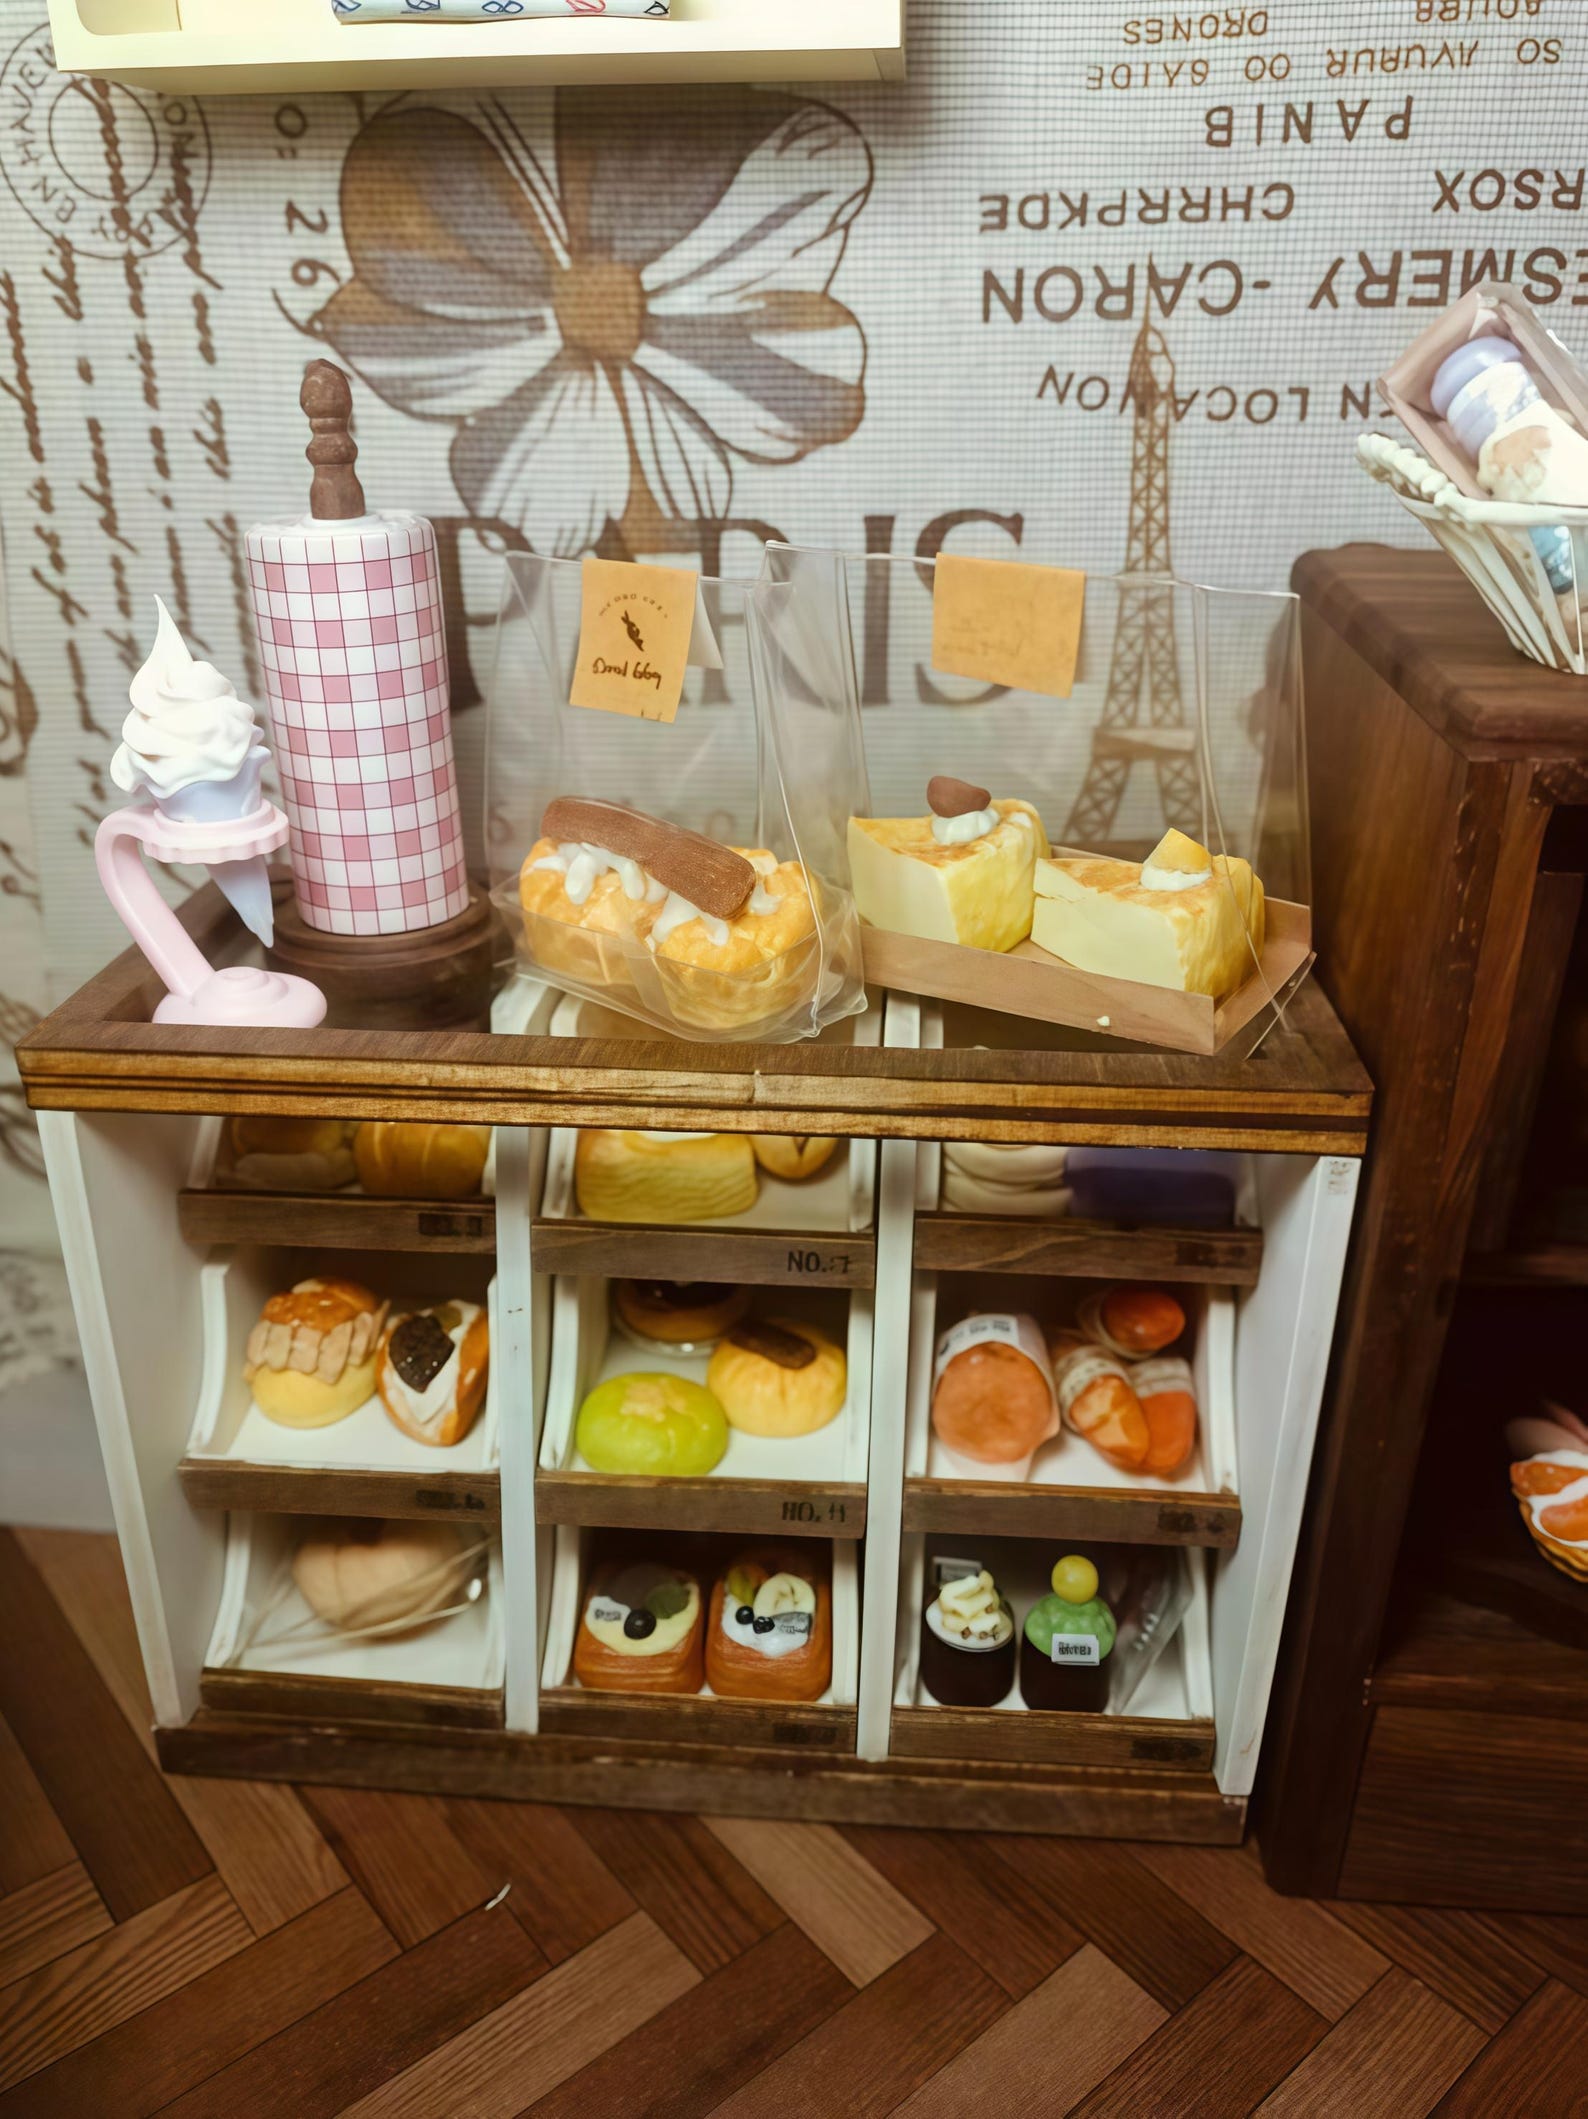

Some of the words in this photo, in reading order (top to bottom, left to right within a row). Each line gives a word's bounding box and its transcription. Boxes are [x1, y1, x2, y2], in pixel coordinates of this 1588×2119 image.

[1204, 95, 1414, 147] PANIB
[978, 181, 1296, 234] CHRRPKDE
[1432, 167, 1586, 213] RSOX
[1341, 382, 1397, 422] N
